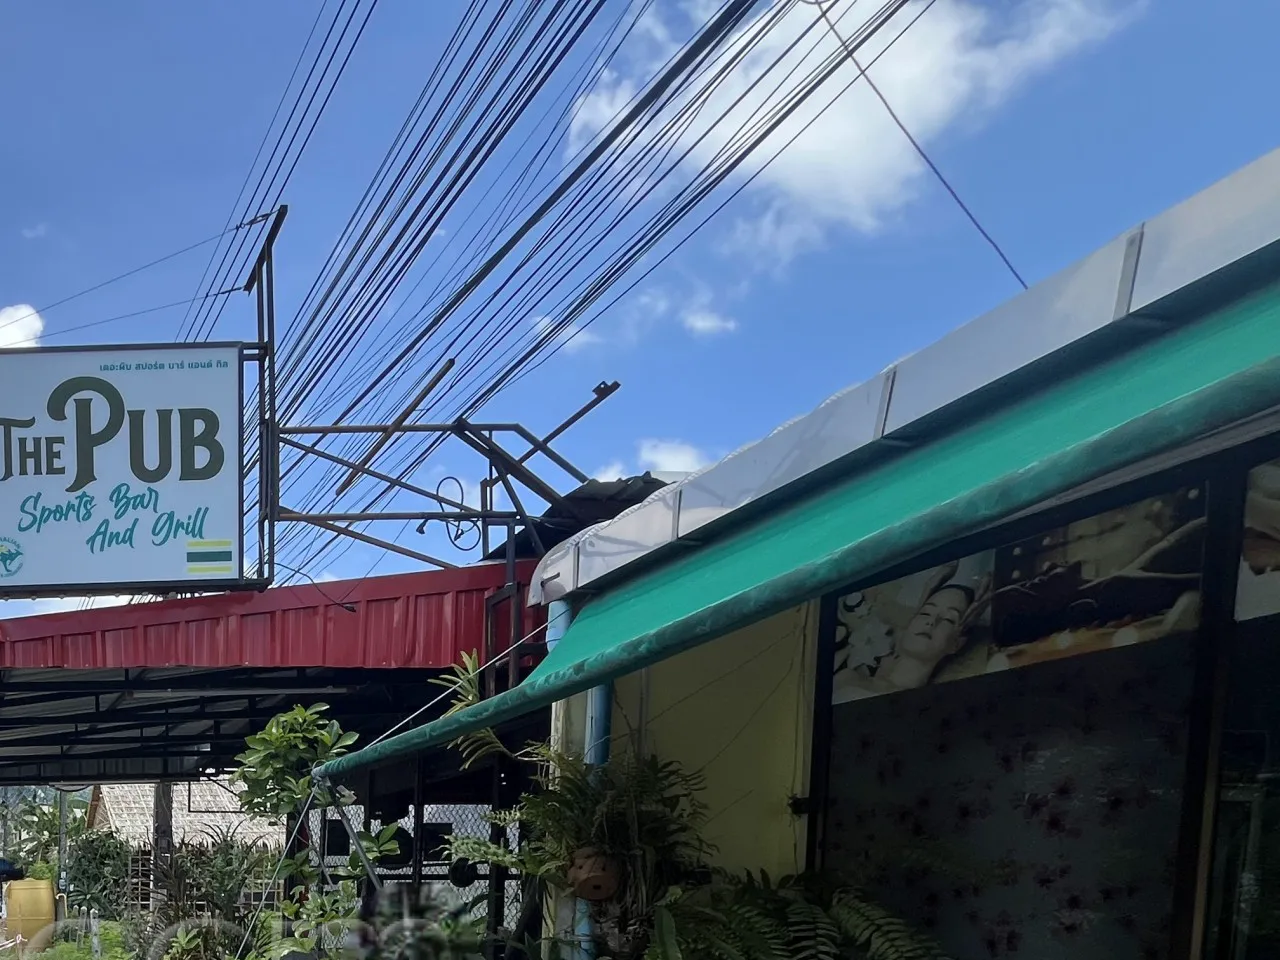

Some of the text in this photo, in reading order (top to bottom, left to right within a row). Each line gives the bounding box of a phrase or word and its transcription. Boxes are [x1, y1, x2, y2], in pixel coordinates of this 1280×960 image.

[17, 483, 160, 533] Sports Bar
[86, 518, 136, 554] And
